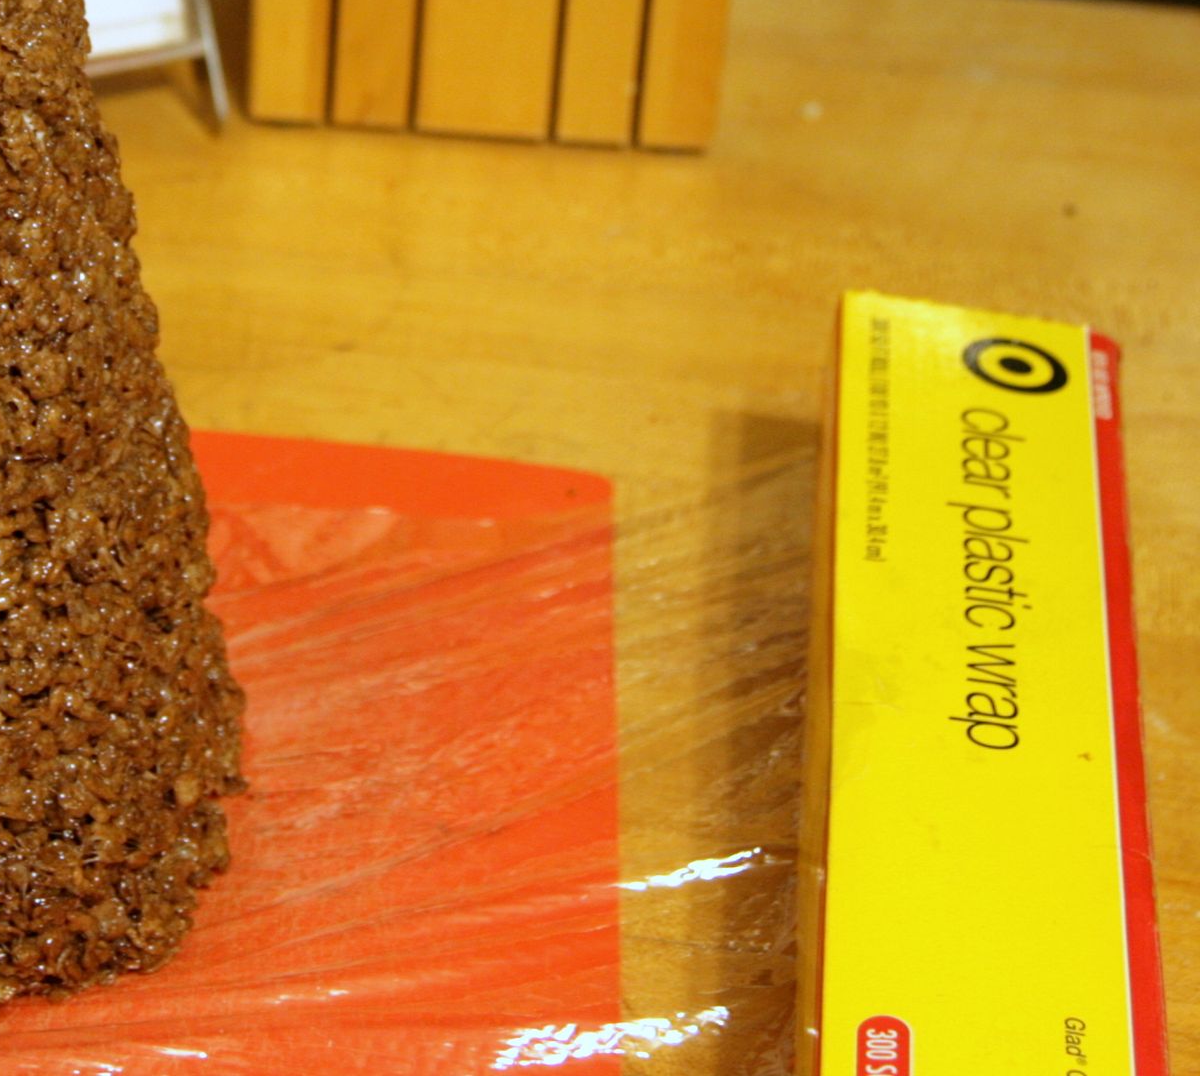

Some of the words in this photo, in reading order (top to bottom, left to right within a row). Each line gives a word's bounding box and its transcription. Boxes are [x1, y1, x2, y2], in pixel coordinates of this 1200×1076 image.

[960, 407, 1027, 500] clear
[946, 500, 1033, 631] plastic
[948, 643, 1020, 751] wrap
[866, 1028, 898, 1060] 300
